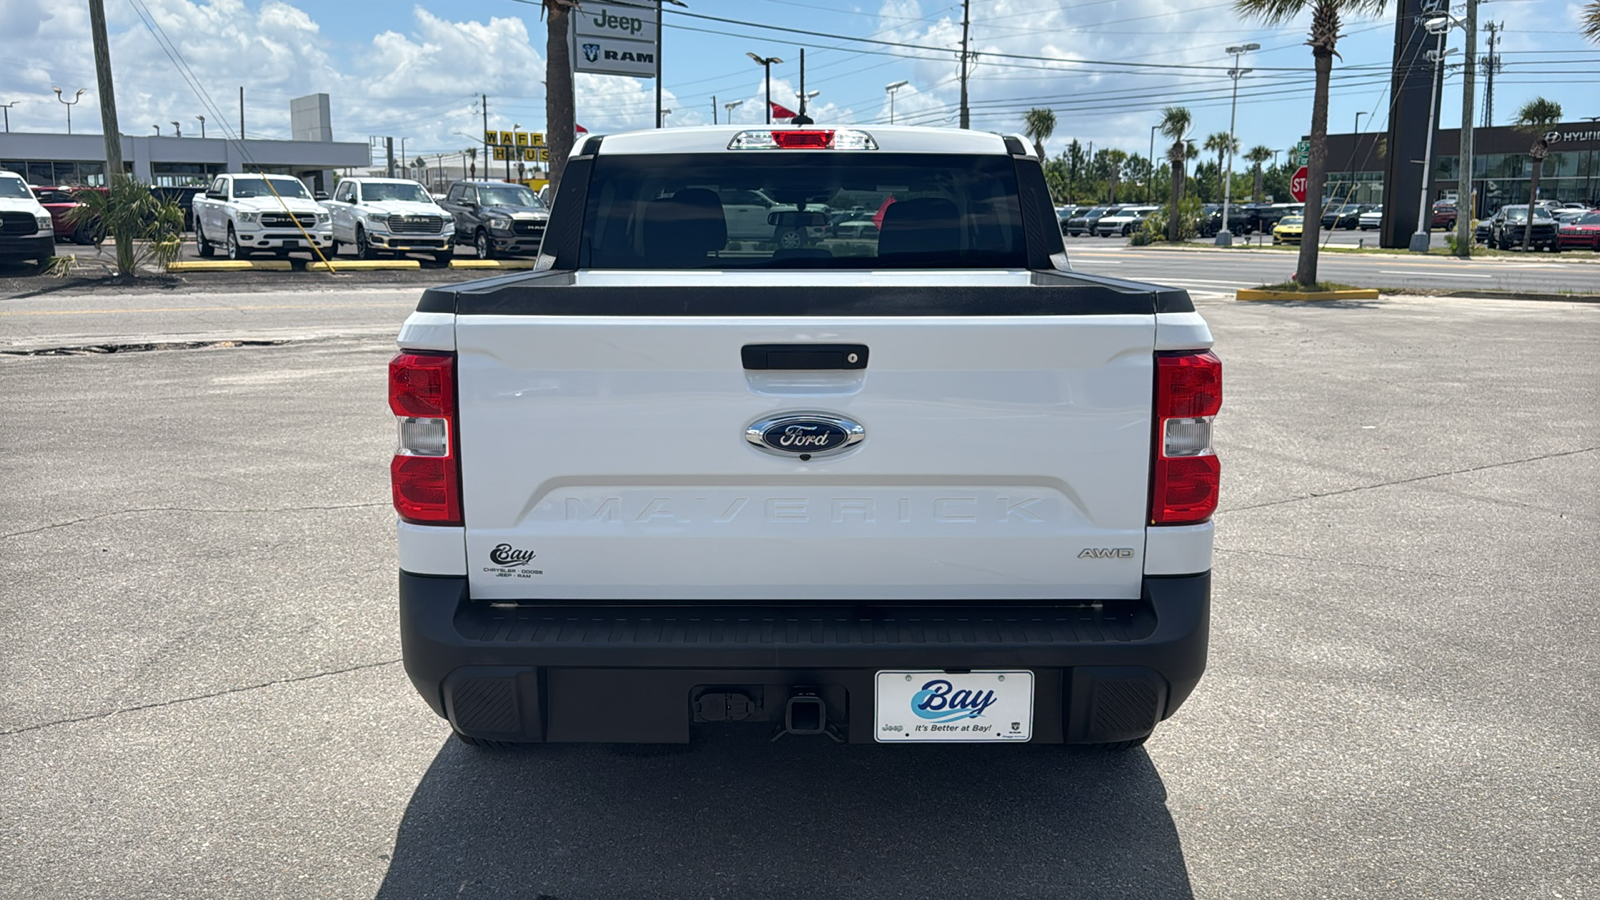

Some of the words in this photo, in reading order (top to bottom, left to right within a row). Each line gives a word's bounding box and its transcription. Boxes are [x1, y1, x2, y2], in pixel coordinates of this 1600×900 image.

[593, 9, 643, 35] Jeep
[604, 50, 654, 63] RAM
[486, 132, 541, 144] WAFF
[496, 149, 549, 160] HUS
[1293, 178, 1307, 192] ST
[780, 425, 830, 446] Ford
[565, 497, 1046, 523] MAVERICK
[495, 543, 536, 565] Bay
[1077, 547, 1135, 558] AWD
[917, 679, 998, 718] Bay
[882, 724, 904, 733] Jeep
[915, 724, 929, 732] It's
[930, 724, 959, 732] Better
[960, 724, 970, 732] at
[972, 724, 993, 733] Bay!
